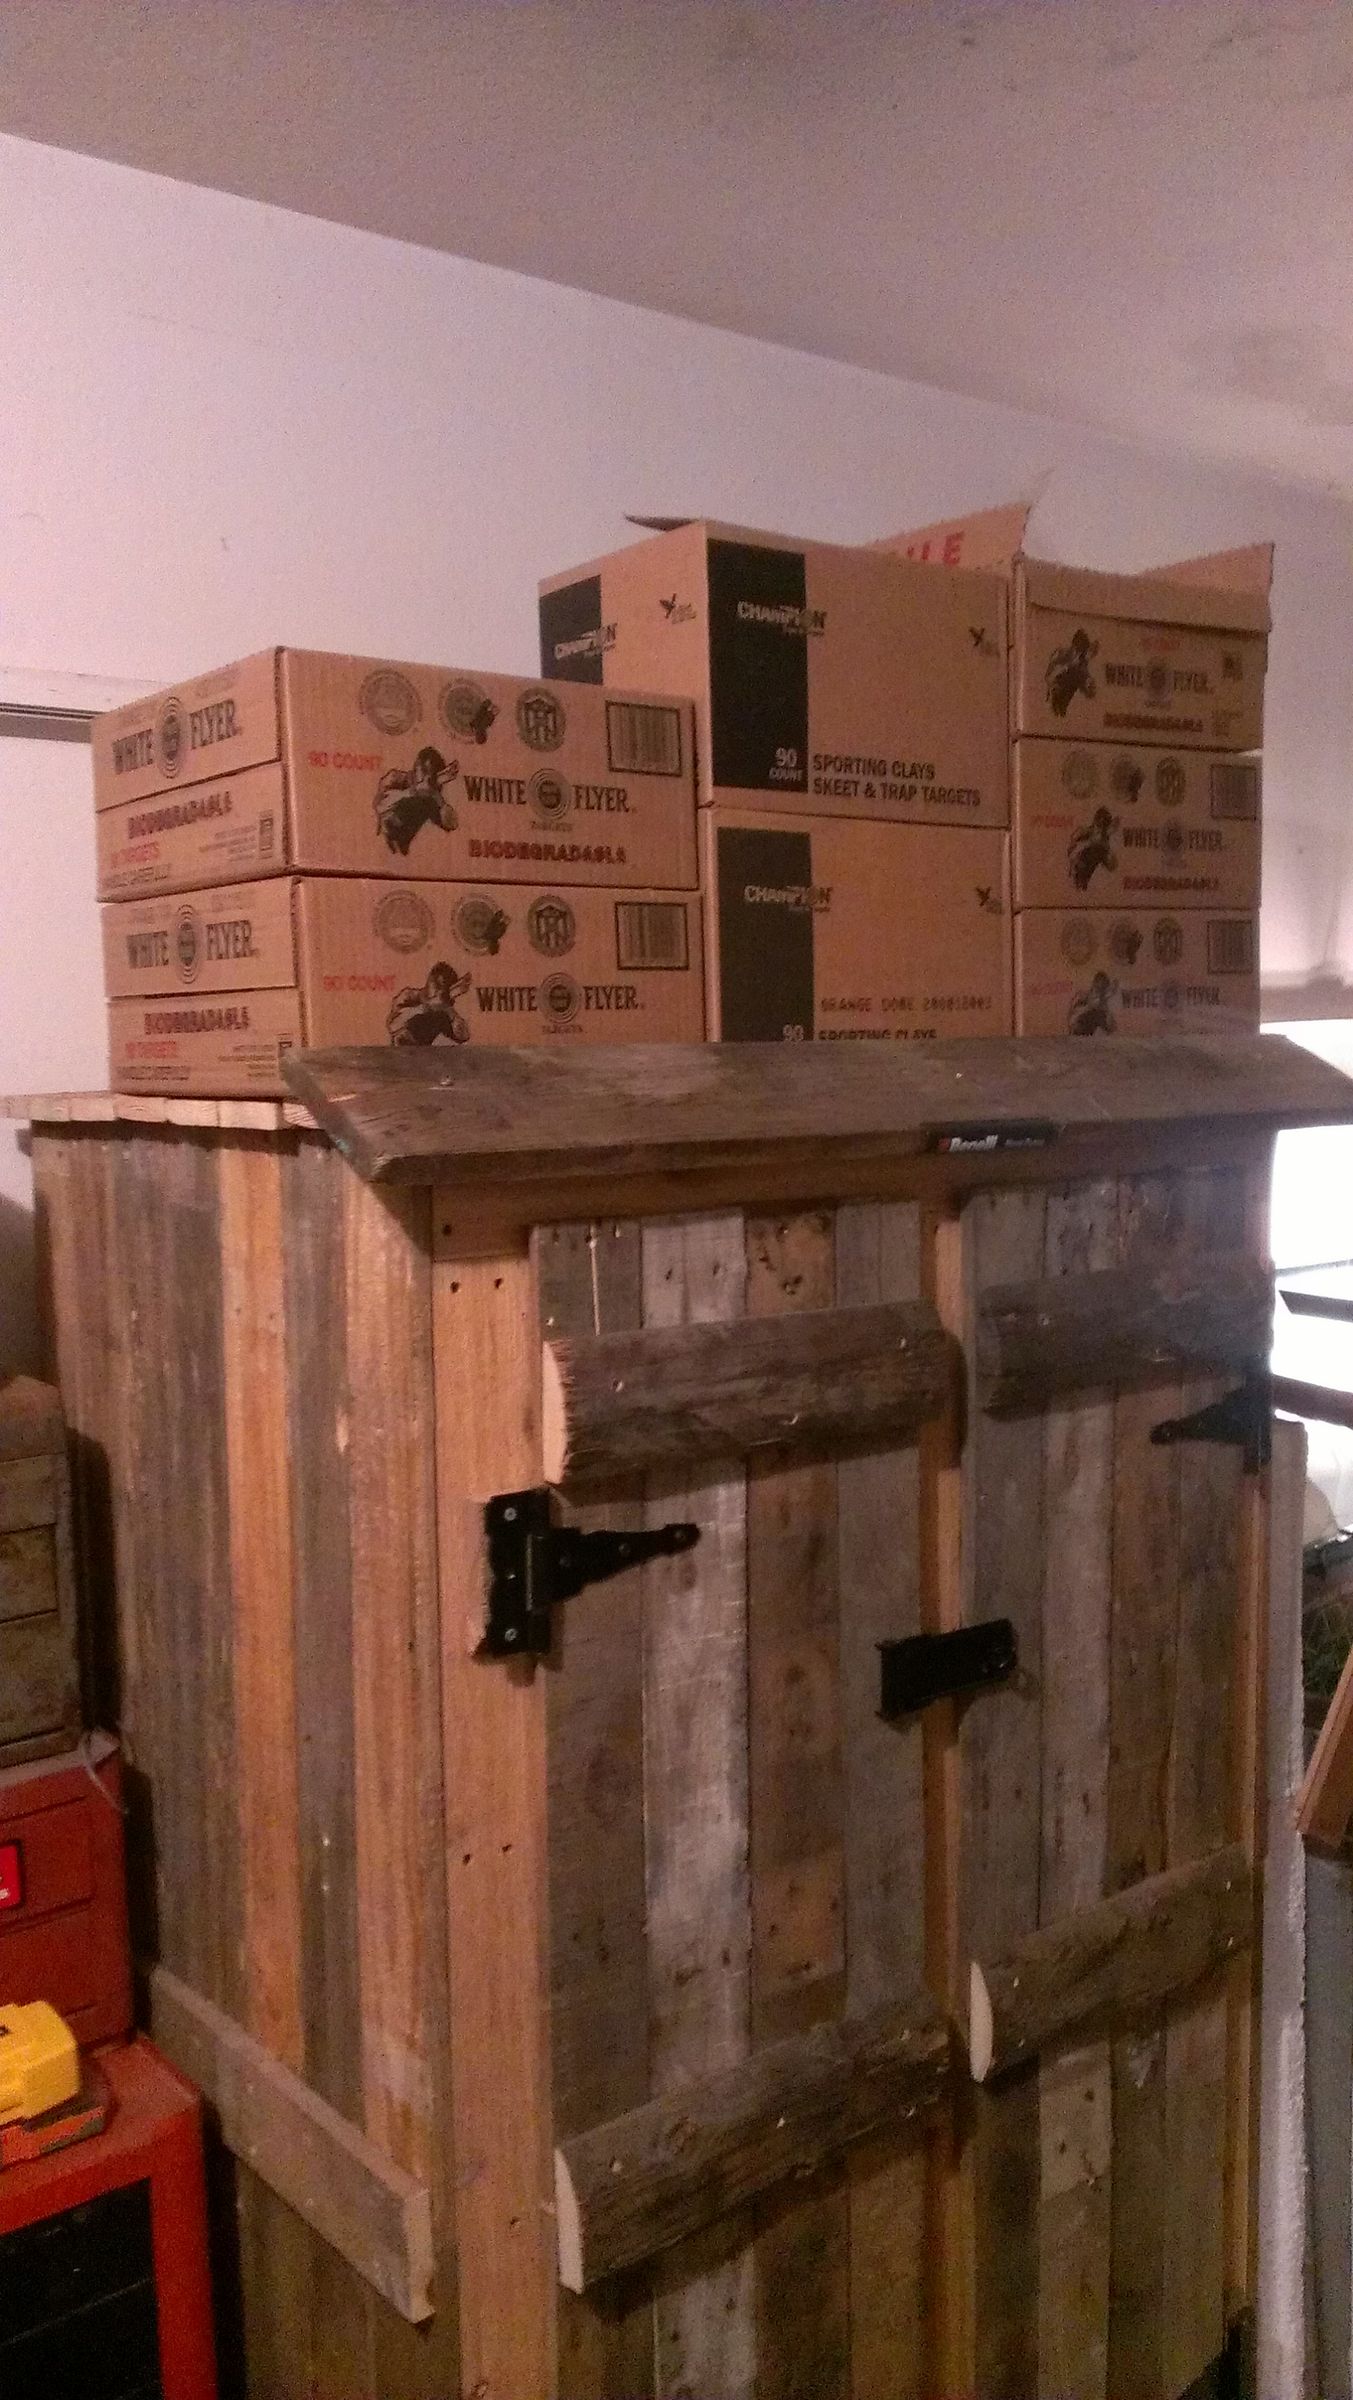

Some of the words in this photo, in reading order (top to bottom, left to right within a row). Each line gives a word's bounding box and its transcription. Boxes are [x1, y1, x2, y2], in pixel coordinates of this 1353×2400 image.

[775, 748, 798, 768] 90
[813, 754, 887, 777] SPORTING
[891, 761, 935, 780] CLAYS
[464, 775, 528, 805] WHITE
[813, 777, 860, 797] SKEET
[864, 782, 877, 799] &
[880, 782, 918, 801] TRAP
[921, 785, 981, 807] TARGETS
[476, 986, 538, 1012] WHITE
